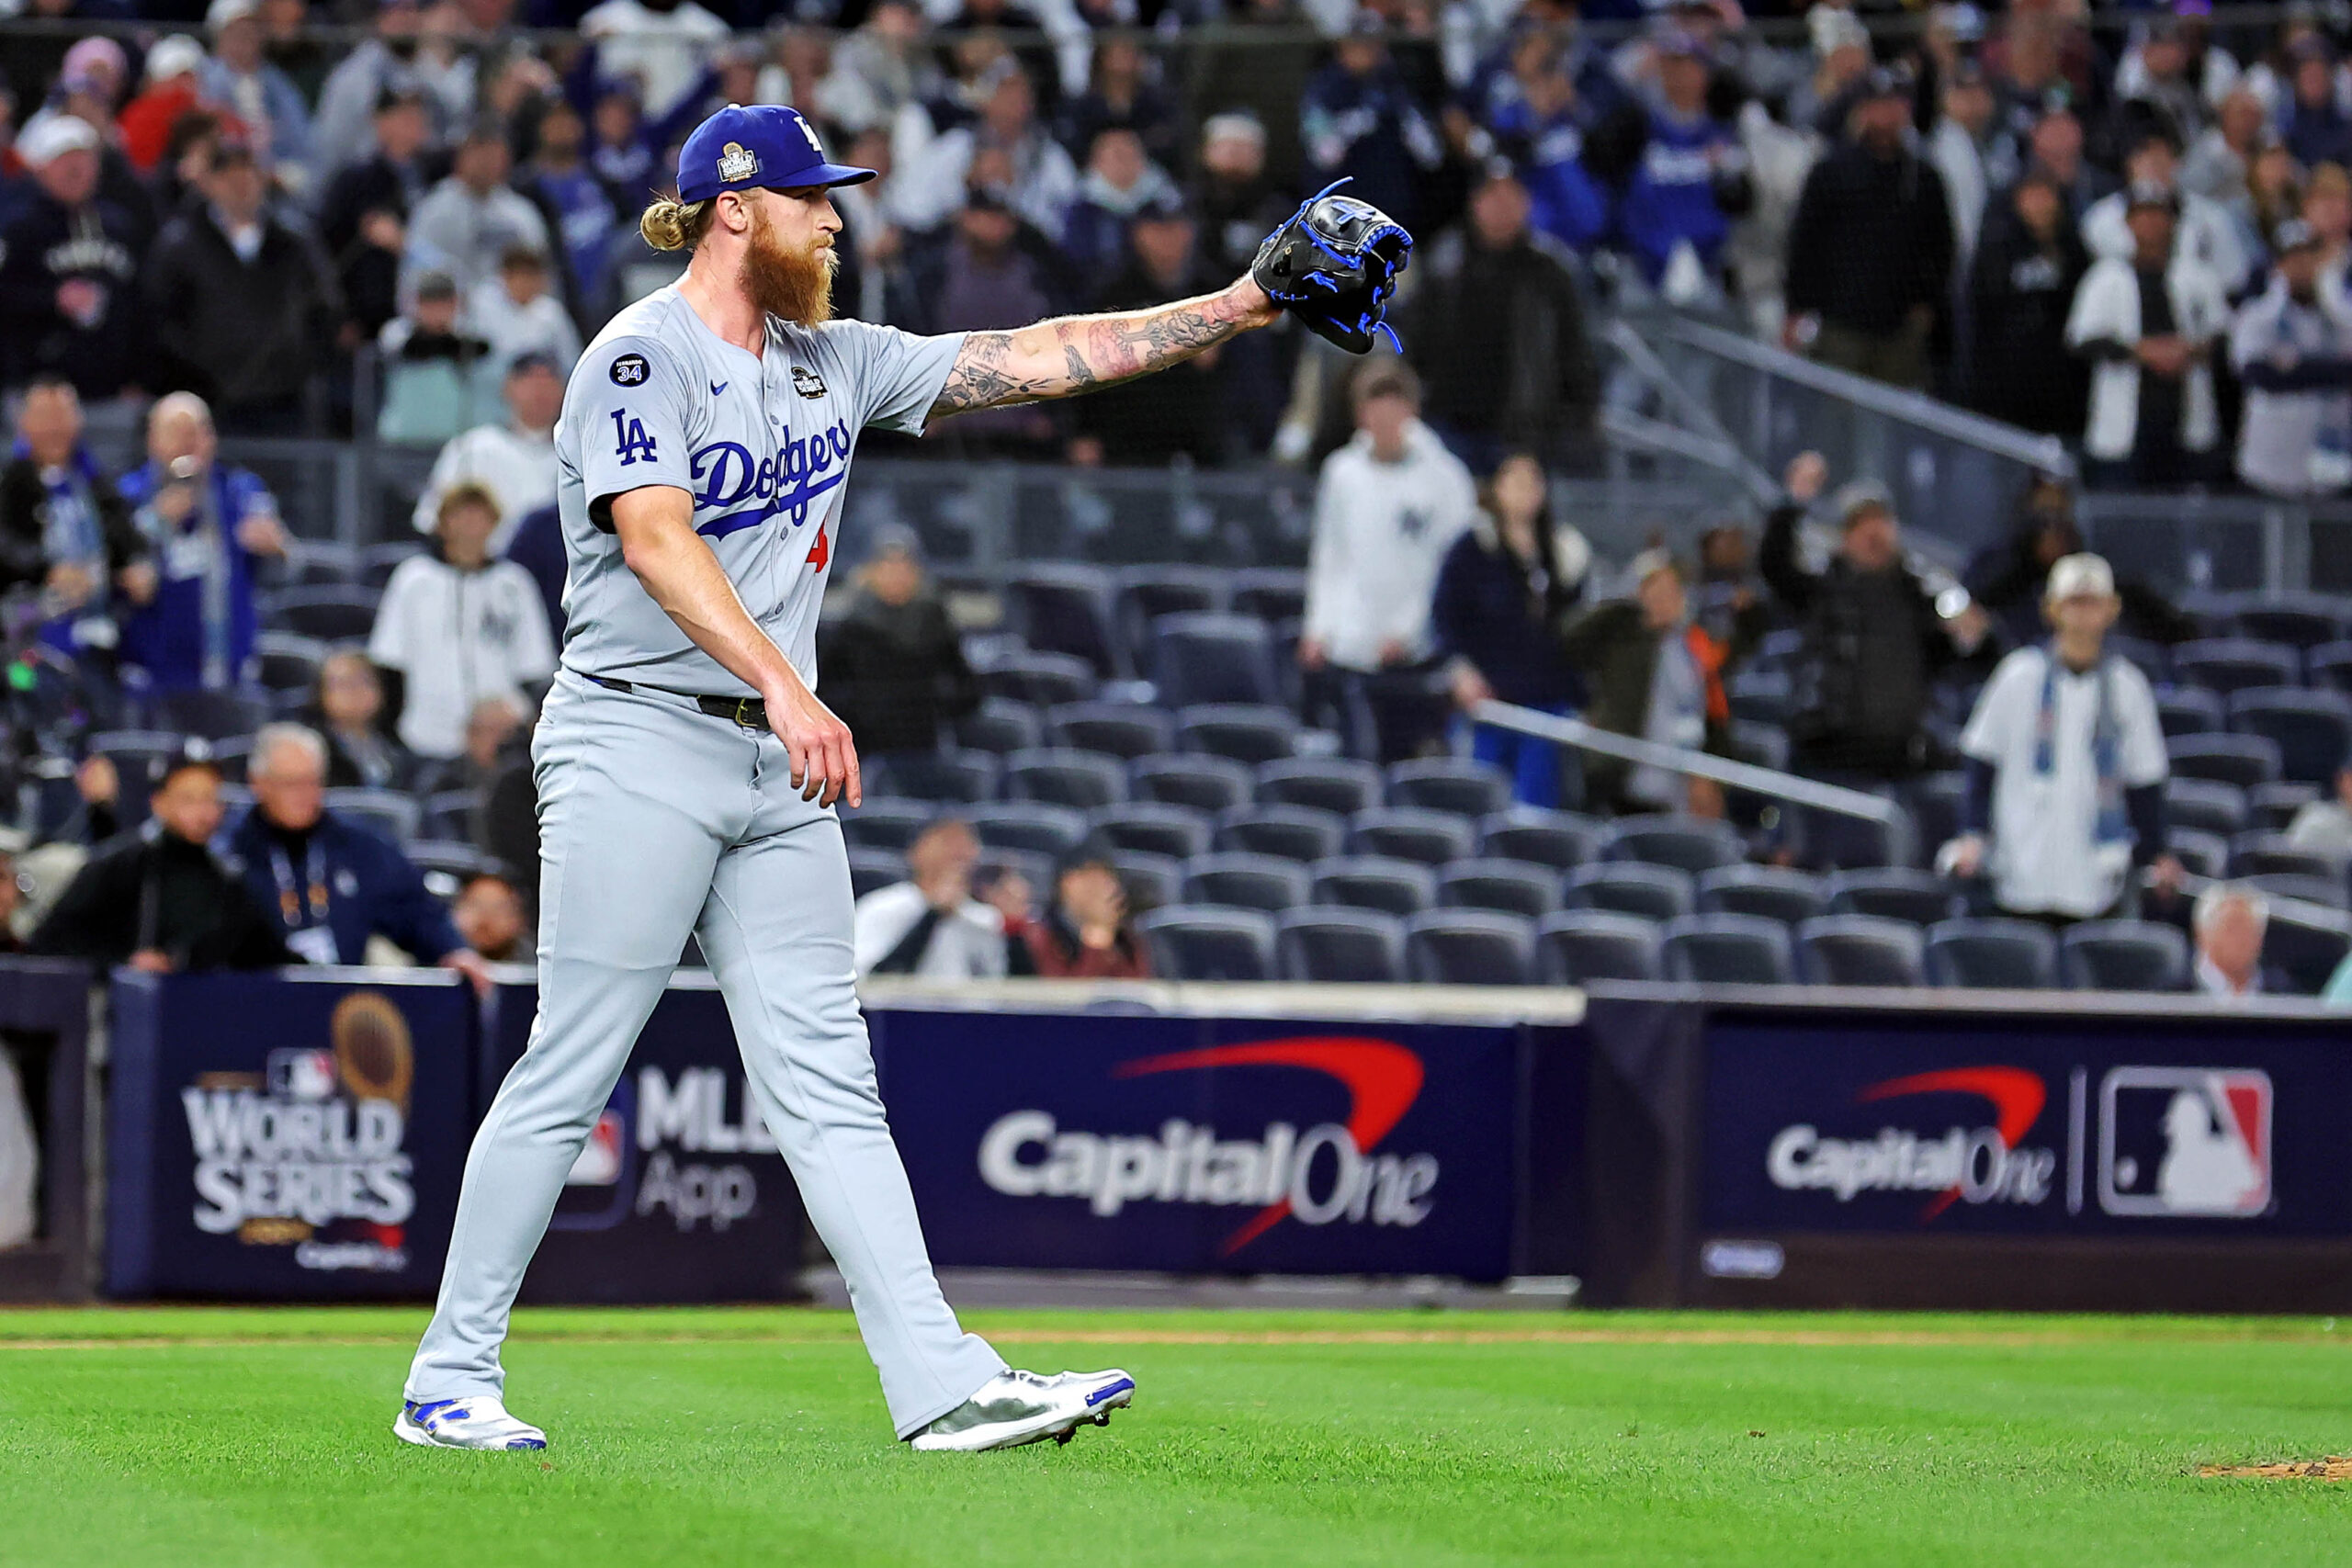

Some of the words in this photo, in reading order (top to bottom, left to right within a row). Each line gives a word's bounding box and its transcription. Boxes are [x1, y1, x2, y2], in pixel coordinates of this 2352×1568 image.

[720, 154, 752, 172] WORLD
[617, 366, 642, 382] 34
[610, 407, 658, 466] LA
[690, 417, 851, 527] Dodgers
[181, 1086, 405, 1159] WORLD
[193, 1153, 416, 1234] SERIES
[636, 1149, 757, 1232] App
